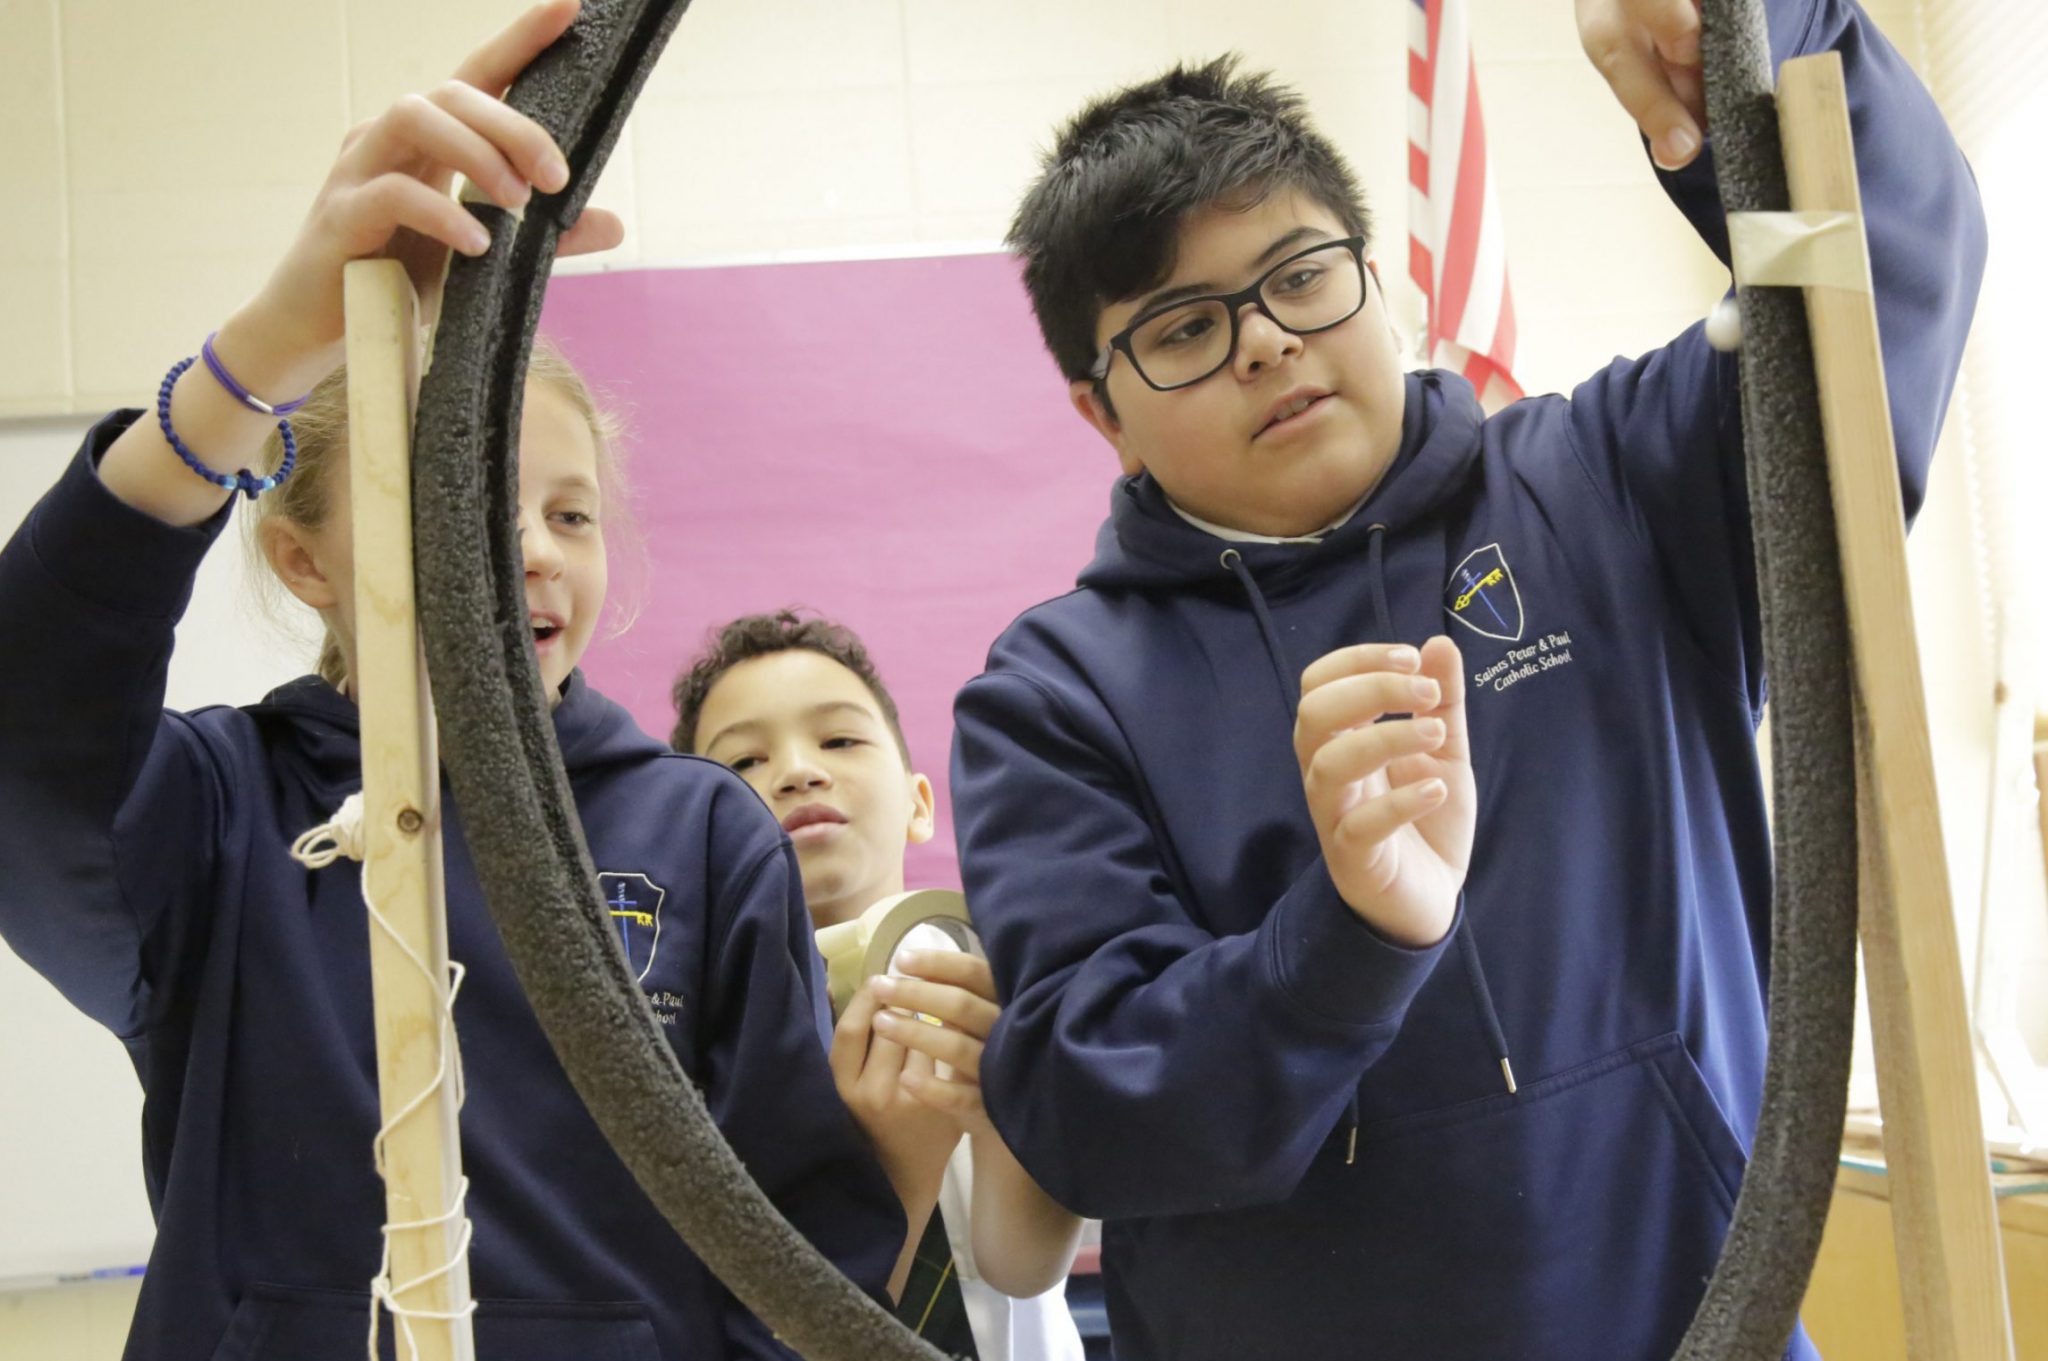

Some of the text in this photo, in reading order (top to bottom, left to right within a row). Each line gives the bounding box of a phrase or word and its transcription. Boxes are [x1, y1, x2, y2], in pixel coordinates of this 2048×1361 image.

[1474, 631, 1571, 687] Saints Peter & Paul
[1494, 649, 1572, 691] Catholic School
[651, 992, 683, 1008] & Paul
[656, 1009, 676, 1025] hool
